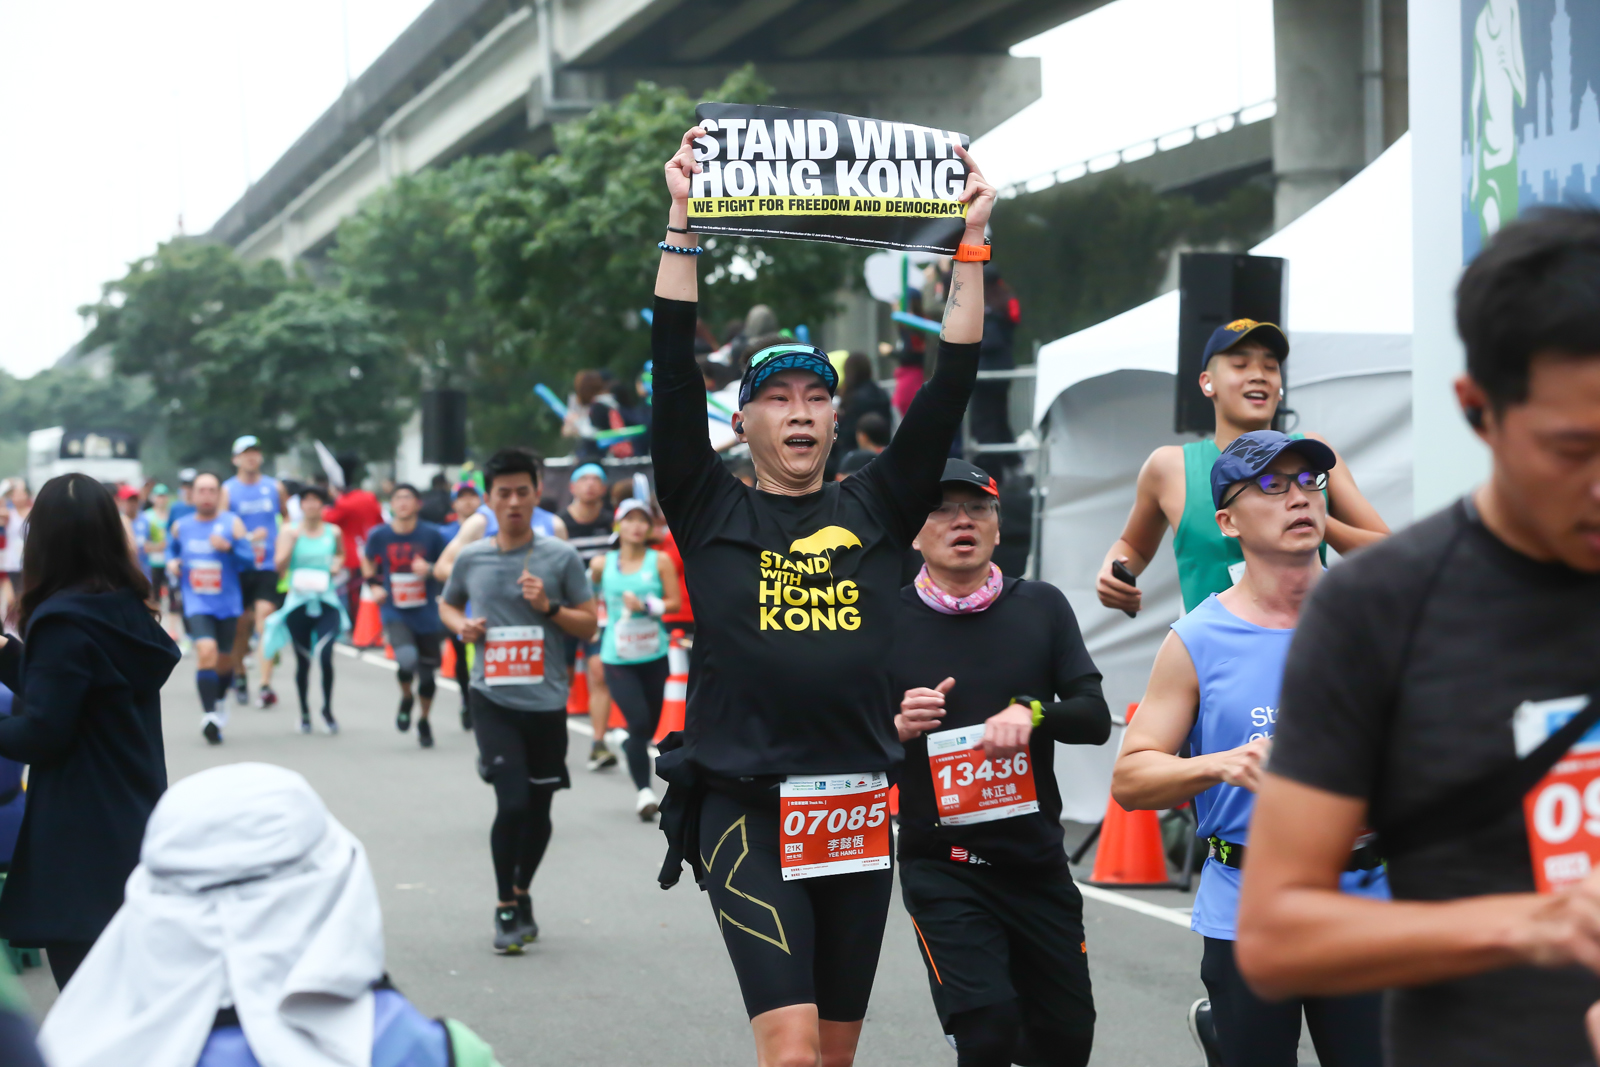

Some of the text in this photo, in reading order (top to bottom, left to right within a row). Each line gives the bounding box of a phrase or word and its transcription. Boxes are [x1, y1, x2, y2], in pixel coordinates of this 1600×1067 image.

[693, 118, 962, 162] STAND WITH
[692, 159, 965, 200] HONG KONG
[693, 199, 965, 215] WE FIGHT FOR FREEDOM AND DEMOCRACY
[760, 550, 829, 575] STAND
[760, 567, 802, 586] WITH
[759, 580, 859, 606] HONG
[760, 606, 862, 632] KONG
[485, 645, 542, 663] 08112
[1250, 705, 1279, 727] St
[938, 751, 1029, 790] 13436
[981, 782, 1017, 799] 林正峰
[978, 797, 999, 807] CHENG
[783, 801, 887, 836] 07085
[787, 844, 802, 853] 21K
[840, 849, 857, 857] HANG
